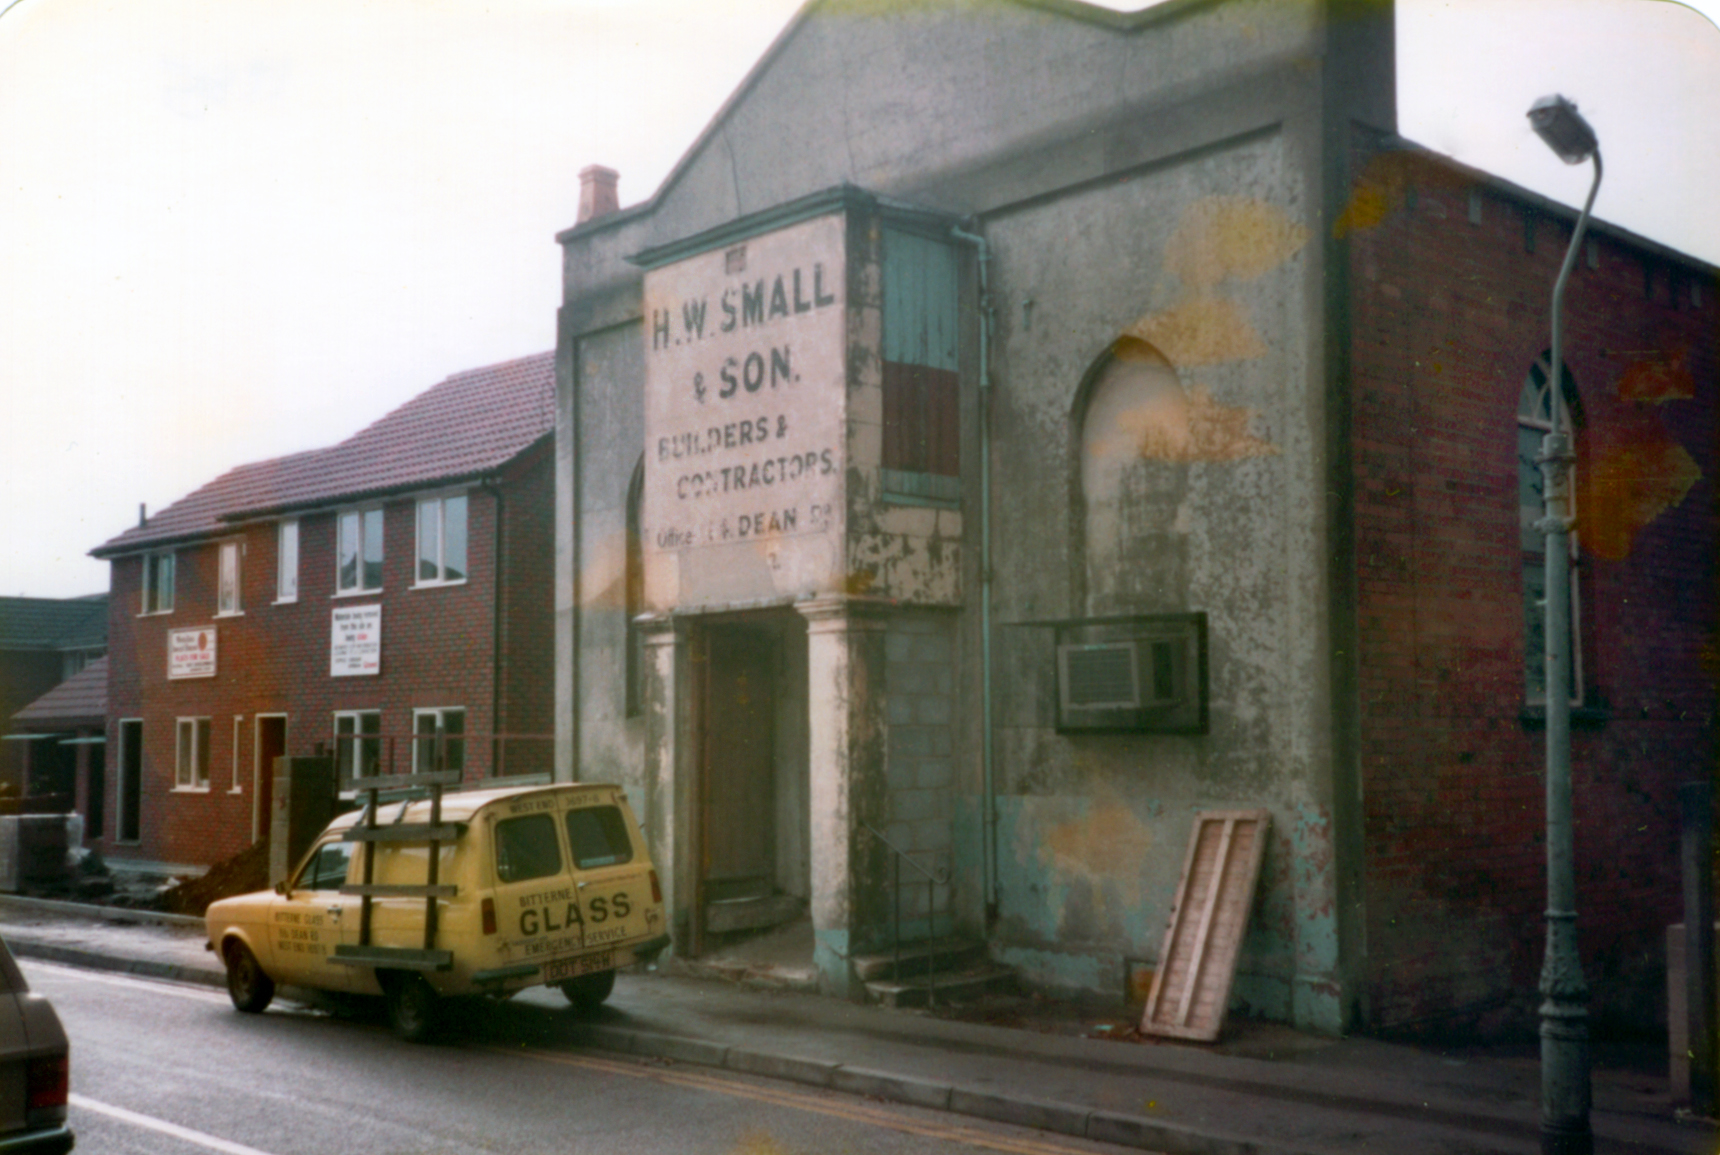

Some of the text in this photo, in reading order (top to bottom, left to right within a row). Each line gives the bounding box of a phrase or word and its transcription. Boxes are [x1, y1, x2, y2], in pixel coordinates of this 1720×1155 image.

[720, 263, 834, 333] SMALL
[658, 414, 788, 461] BUILDERS &
[738, 508, 796, 537] DEAN
[519, 888, 573, 908] BITTERNE
[520, 892, 631, 936] GLASS
[525, 926, 626, 955] EMERGENCY SERVICE
